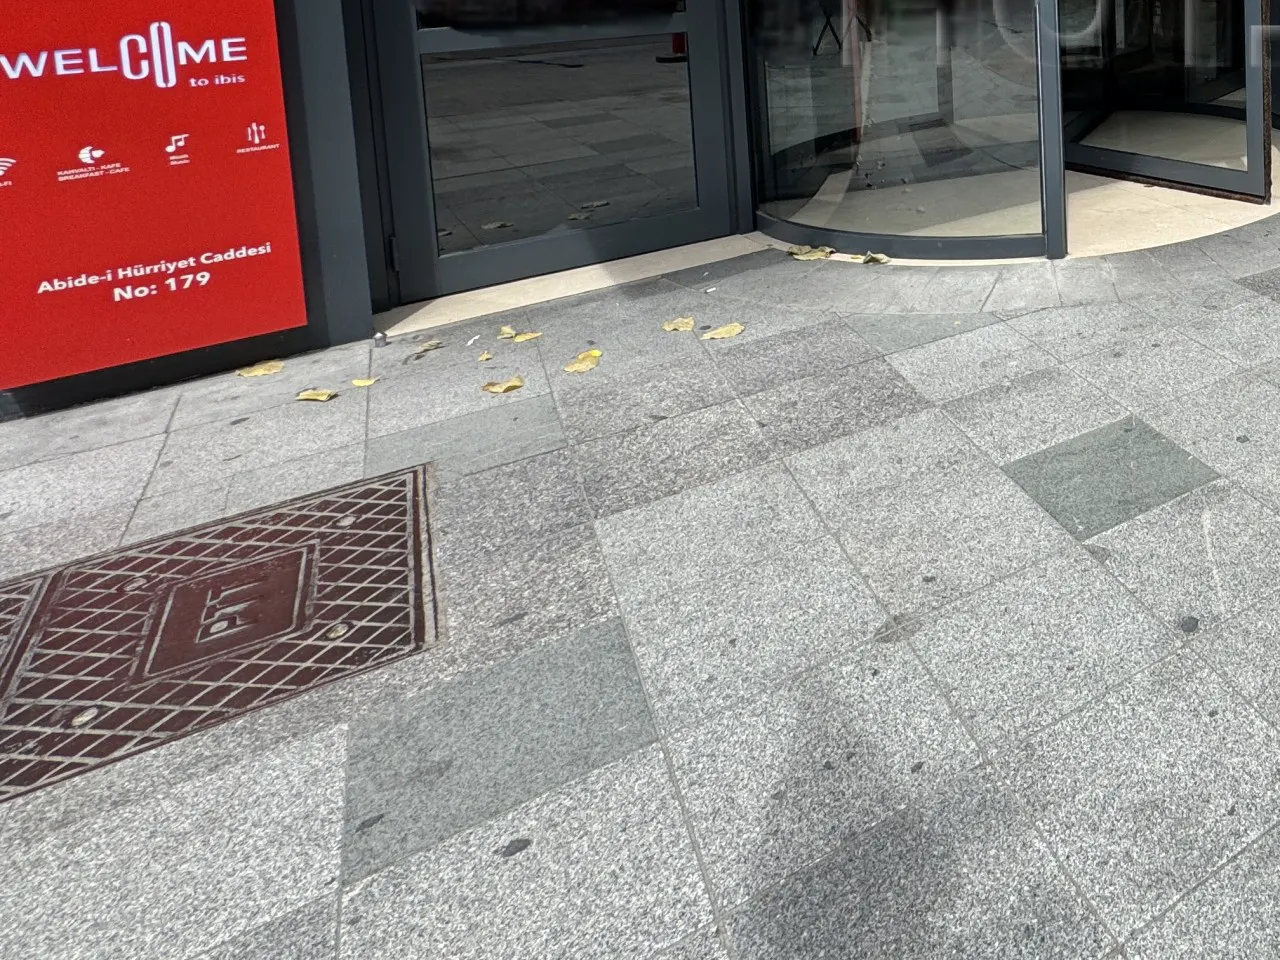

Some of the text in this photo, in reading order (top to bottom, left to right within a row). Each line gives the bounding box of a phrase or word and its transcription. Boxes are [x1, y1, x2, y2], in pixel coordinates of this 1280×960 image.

[0, 21, 248, 88] WELCOME
[189, 73, 246, 87] to ibis
[37, 242, 272, 294] Abide-i Hürriyet Caddesi
[113, 271, 211, 302] No: 179
